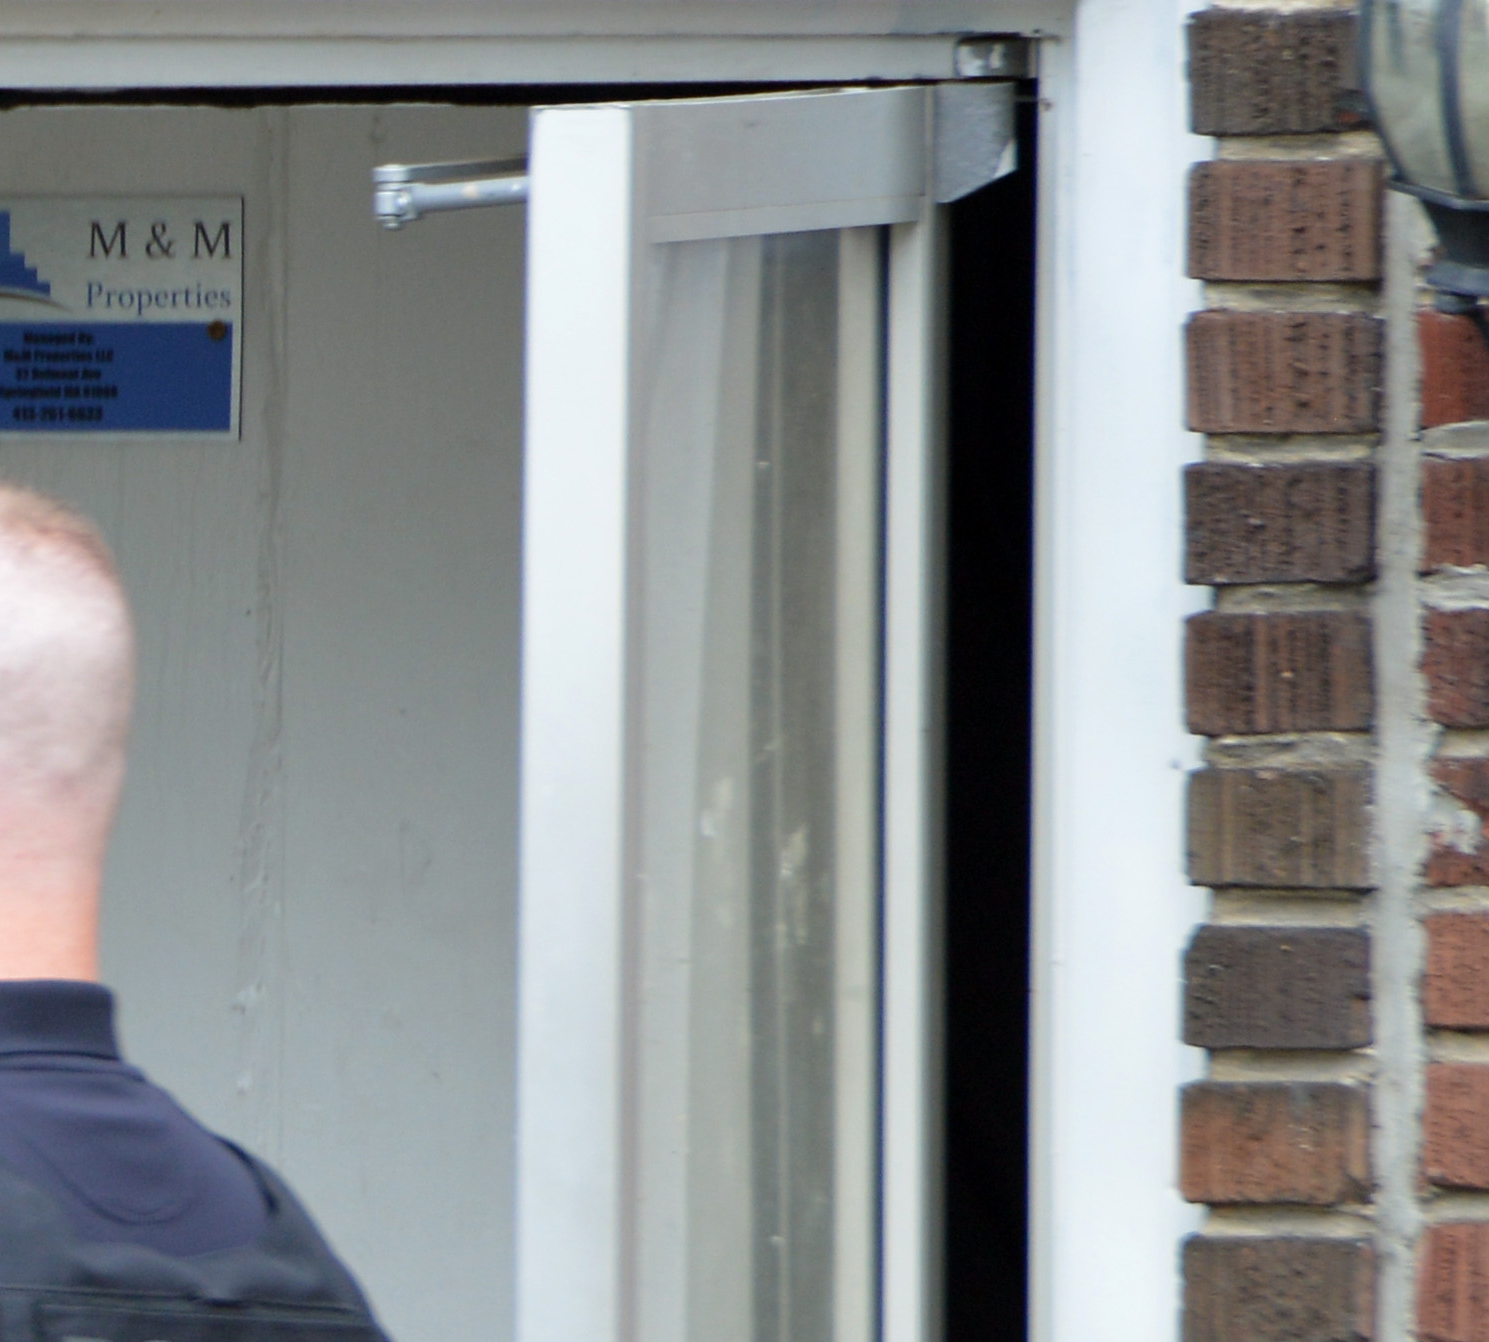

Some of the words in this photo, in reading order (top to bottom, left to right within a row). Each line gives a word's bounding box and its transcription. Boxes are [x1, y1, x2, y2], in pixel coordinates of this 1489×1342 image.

[89, 220, 127, 259] M
[146, 220, 174, 258] &
[193, 220, 231, 259] M
[87, 281, 231, 315] Properties
